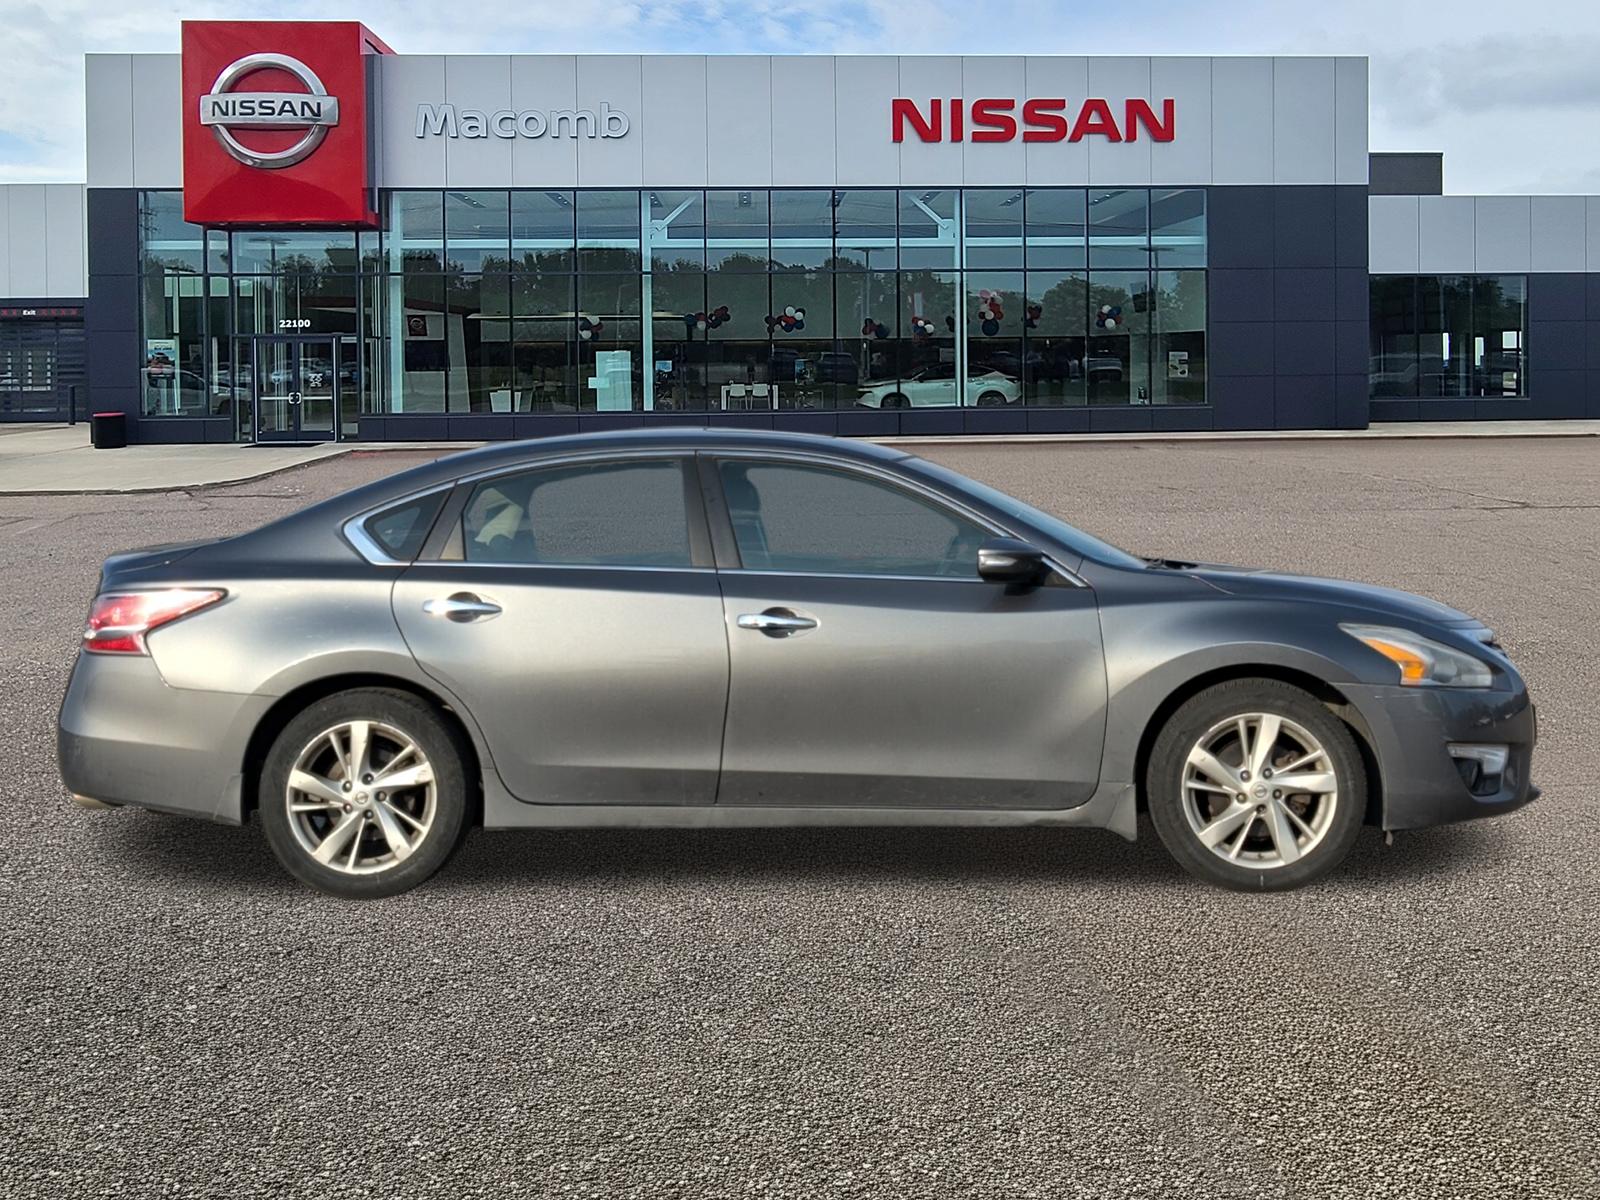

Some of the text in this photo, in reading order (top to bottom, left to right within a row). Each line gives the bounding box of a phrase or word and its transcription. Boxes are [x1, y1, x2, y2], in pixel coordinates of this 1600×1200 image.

[211, 99, 322, 119] NISSAN
[415, 102, 630, 139] Macomb
[891, 98, 1175, 143] NISSAN
[279, 319, 311, 328] 22100
